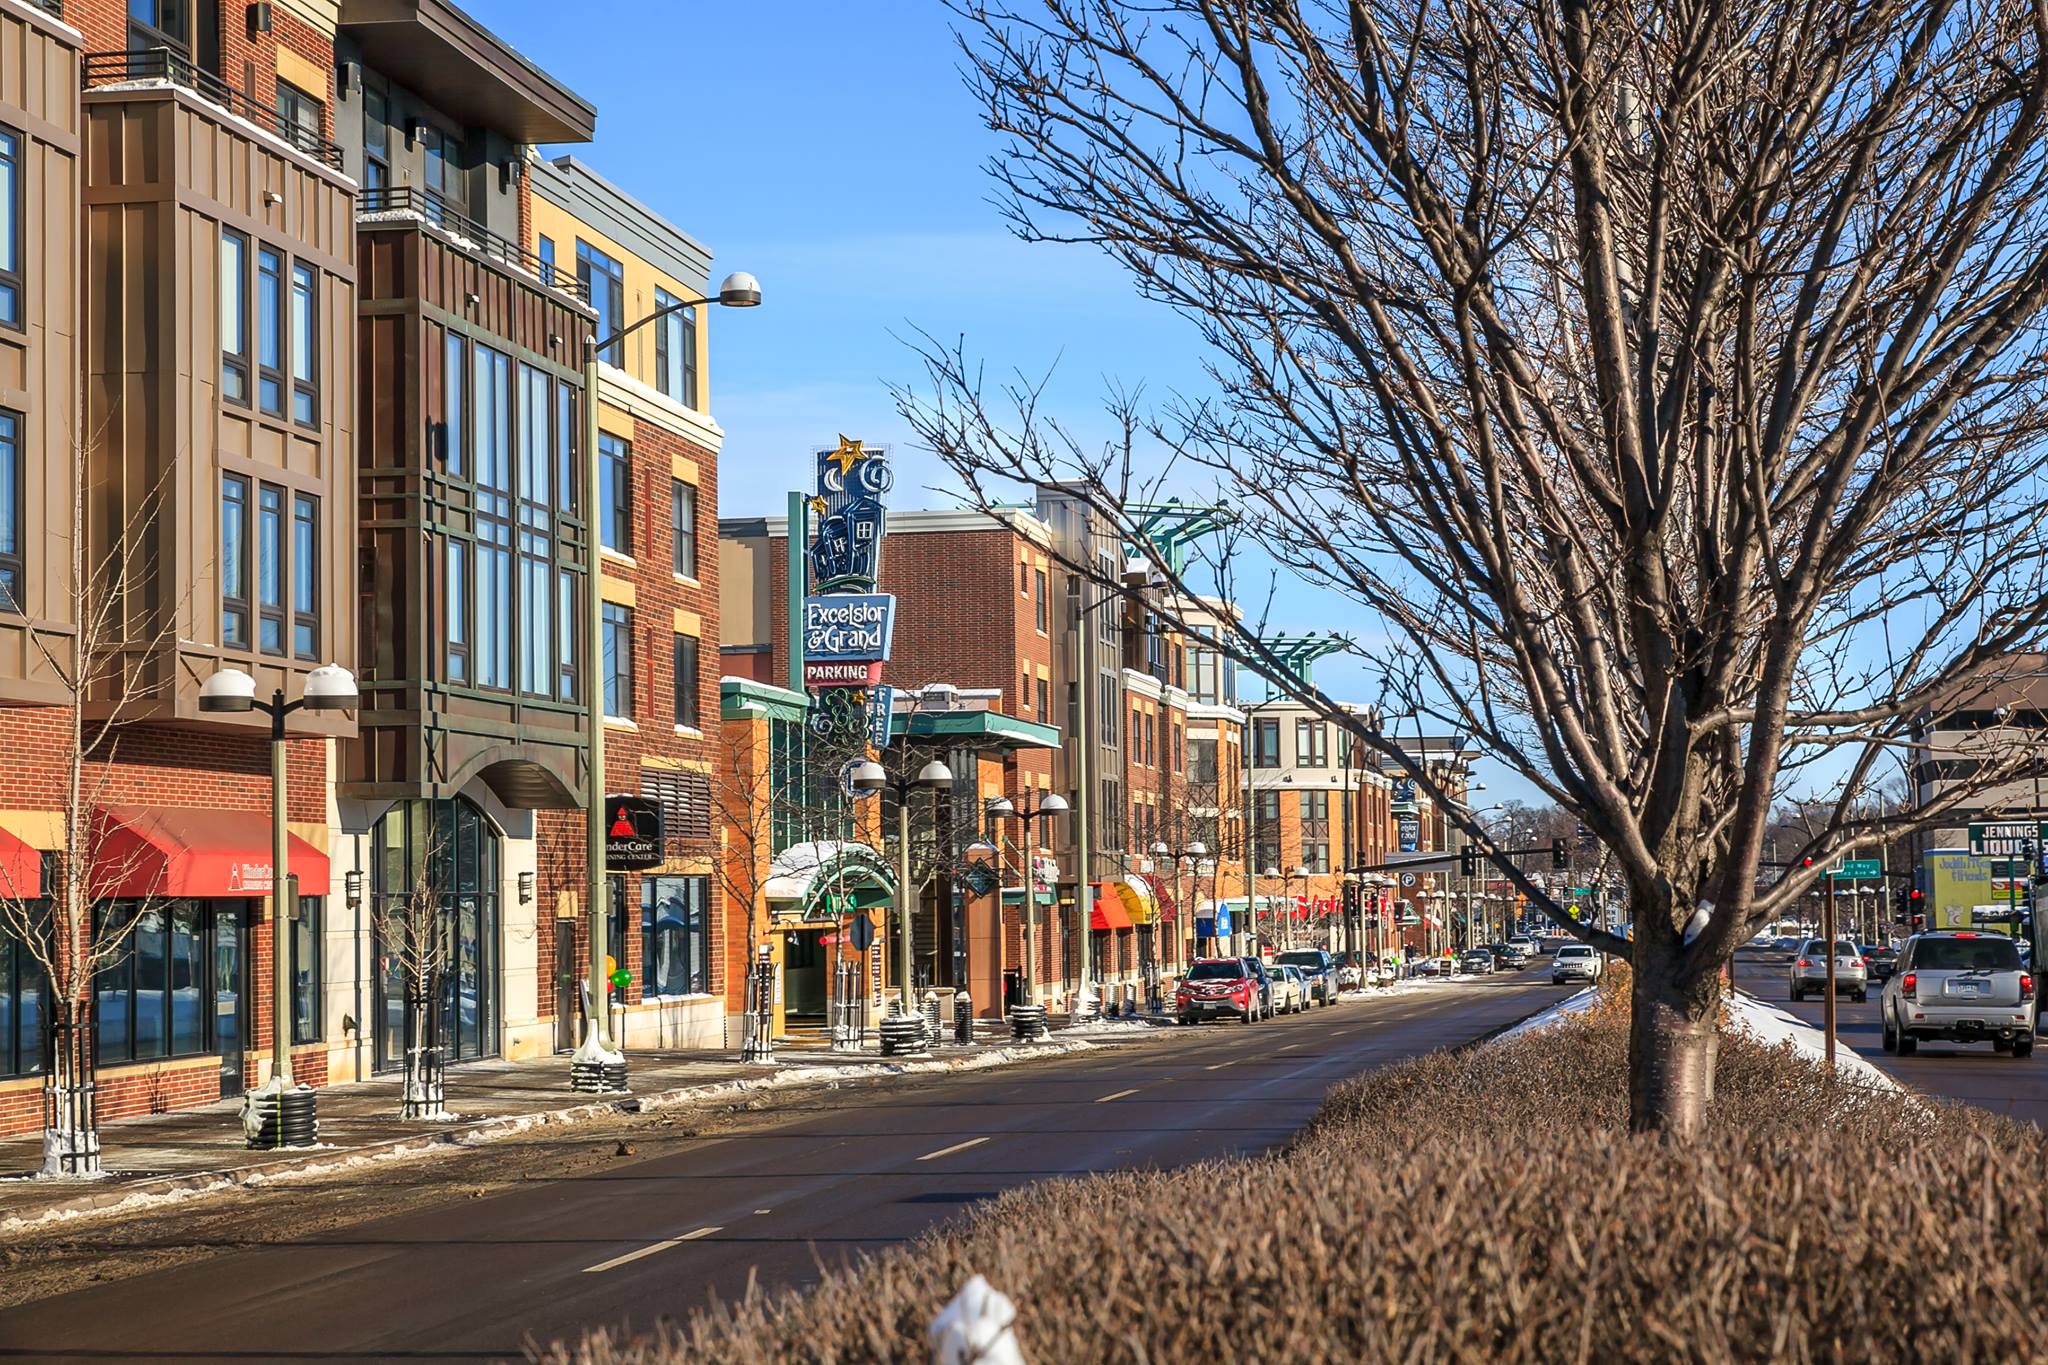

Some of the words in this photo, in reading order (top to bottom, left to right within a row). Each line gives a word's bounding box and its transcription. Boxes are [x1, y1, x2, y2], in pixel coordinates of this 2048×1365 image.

[807, 602, 887, 629] Excelsior
[807, 664, 868, 679] PARKING
[874, 687, 886, 746] FREE
[1982, 825, 2038, 838] JENNINGS
[606, 841, 653, 851] nderCare
